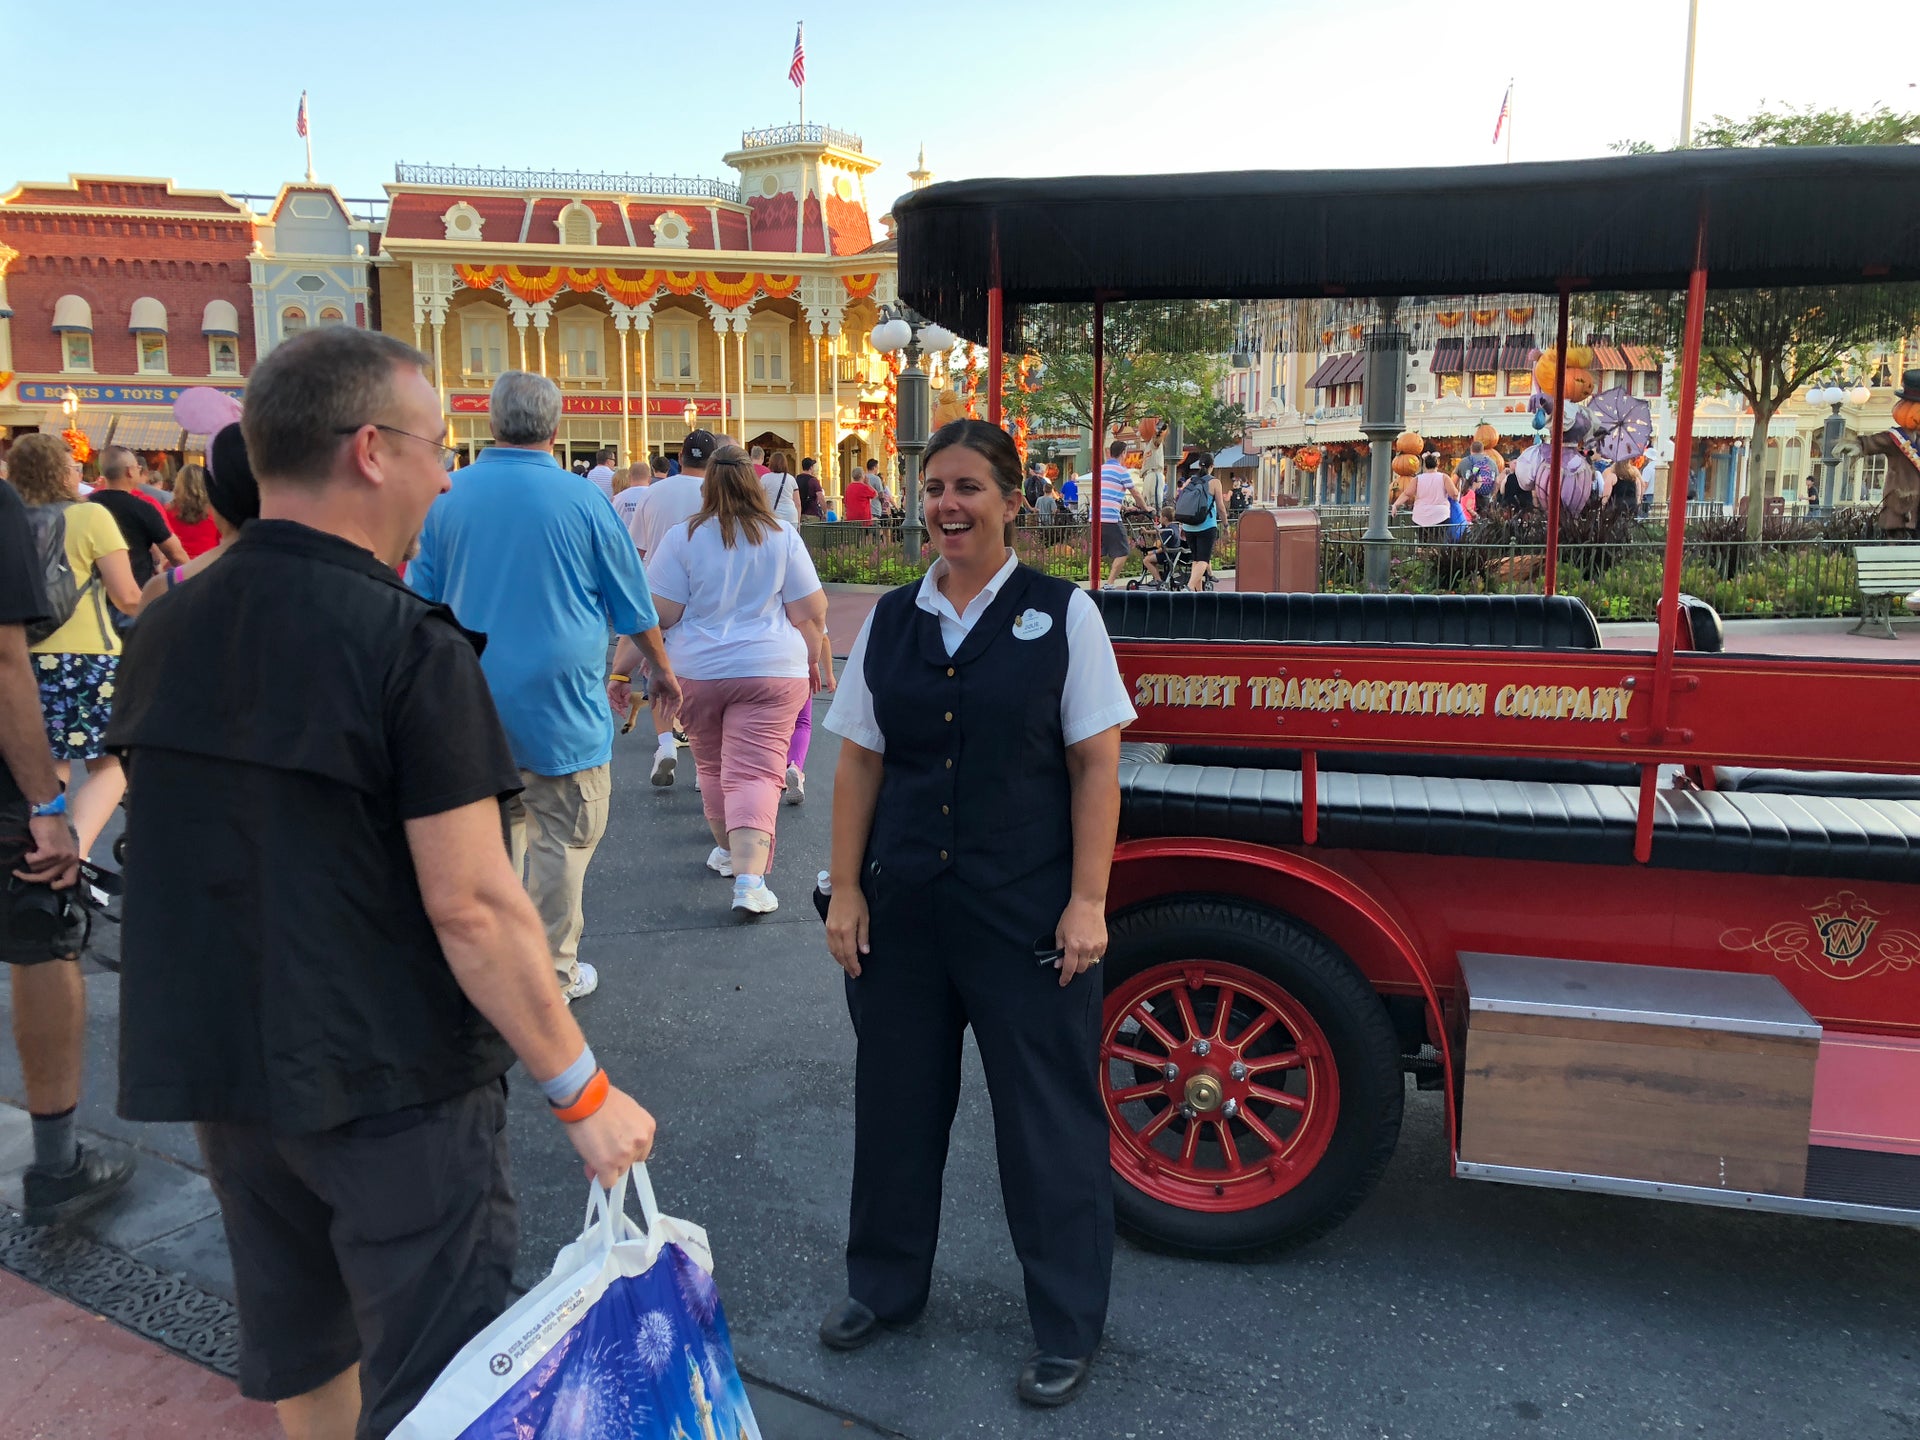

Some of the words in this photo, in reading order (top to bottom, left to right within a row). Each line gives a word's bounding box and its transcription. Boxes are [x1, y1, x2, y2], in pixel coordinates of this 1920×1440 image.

[120, 389, 164, 400] TOYS
[567, 399, 661, 412] PORIUM
[1135, 673, 1241, 709] STREET
[1247, 676, 1487, 716] TRANSPORTATION
[1494, 684, 1633, 721] COMPANY
